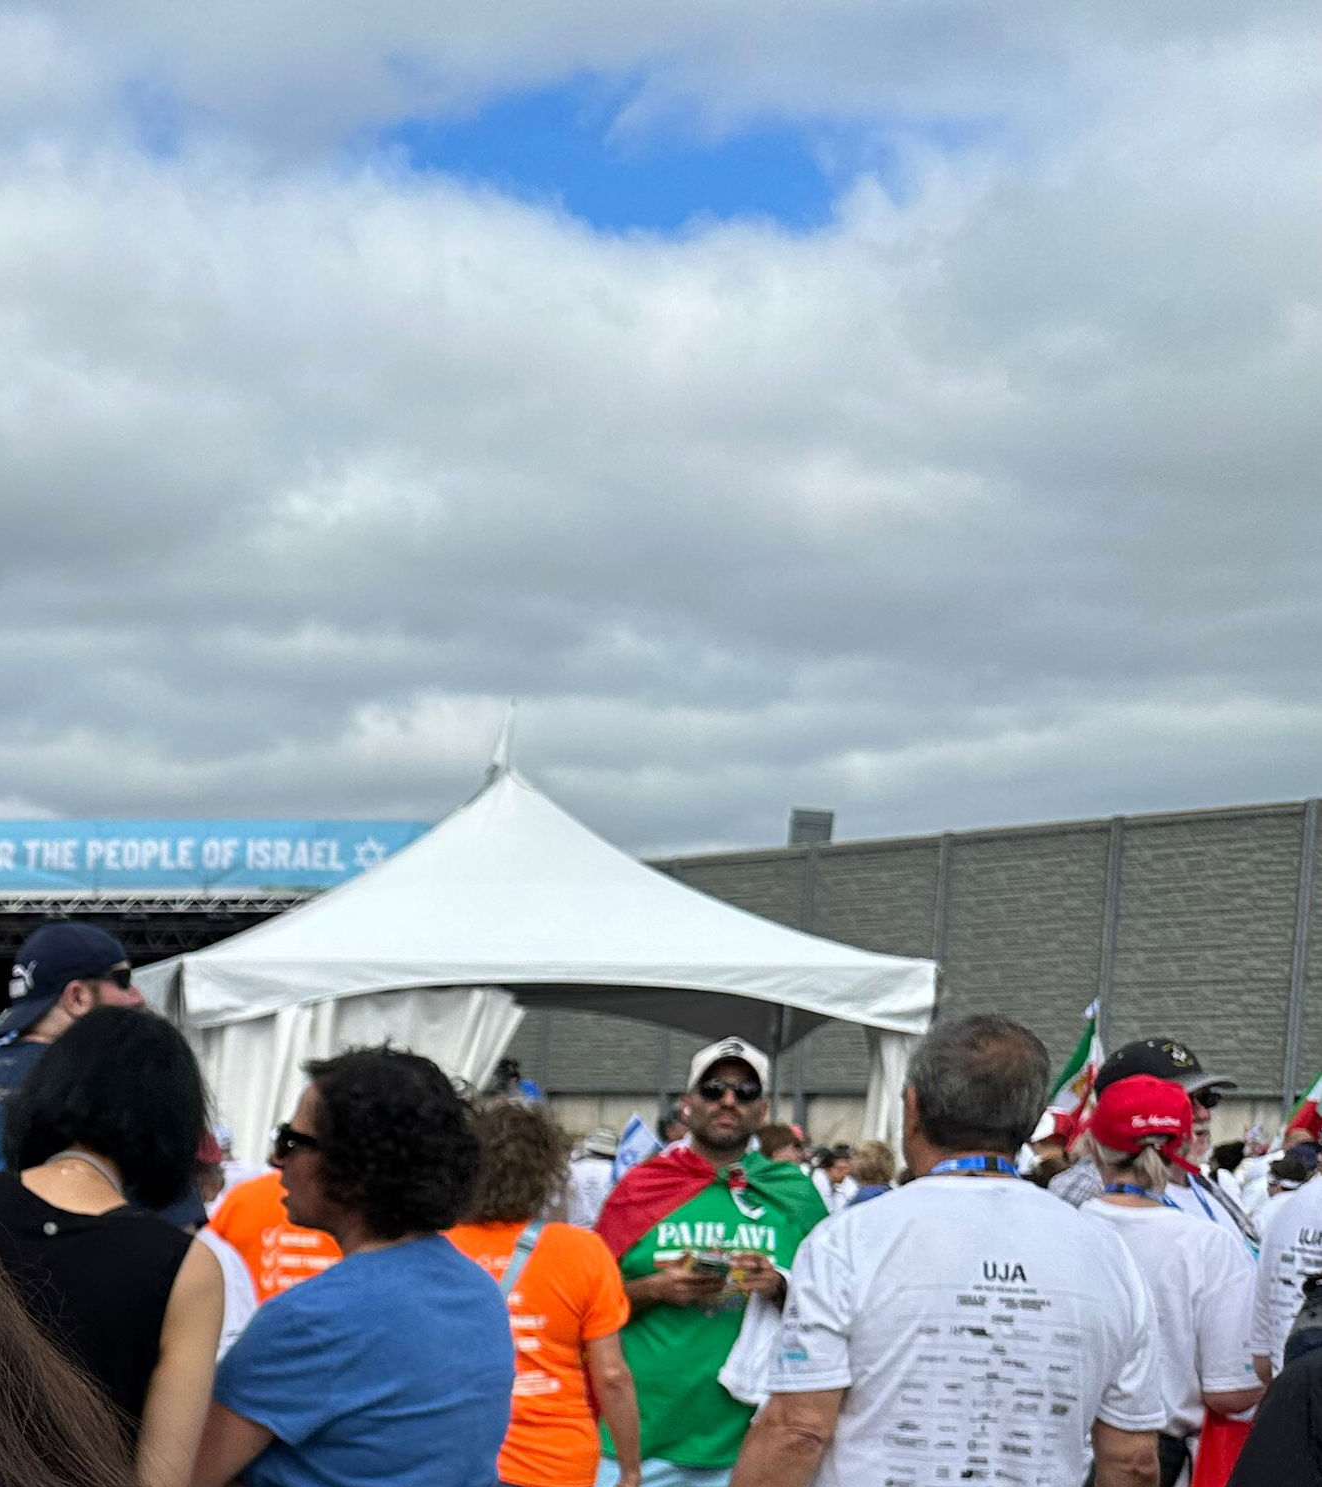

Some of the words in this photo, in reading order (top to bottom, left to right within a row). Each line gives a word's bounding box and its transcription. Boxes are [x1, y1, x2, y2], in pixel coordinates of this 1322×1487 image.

[23, 839, 78, 871] THE
[85, 838, 194, 871] PEOPLE
[201, 838, 240, 870] OF
[246, 838, 345, 871] ISRAEL
[657, 1221, 776, 1250] PAHLAVI
[983, 1260, 1028, 1283] UJA
